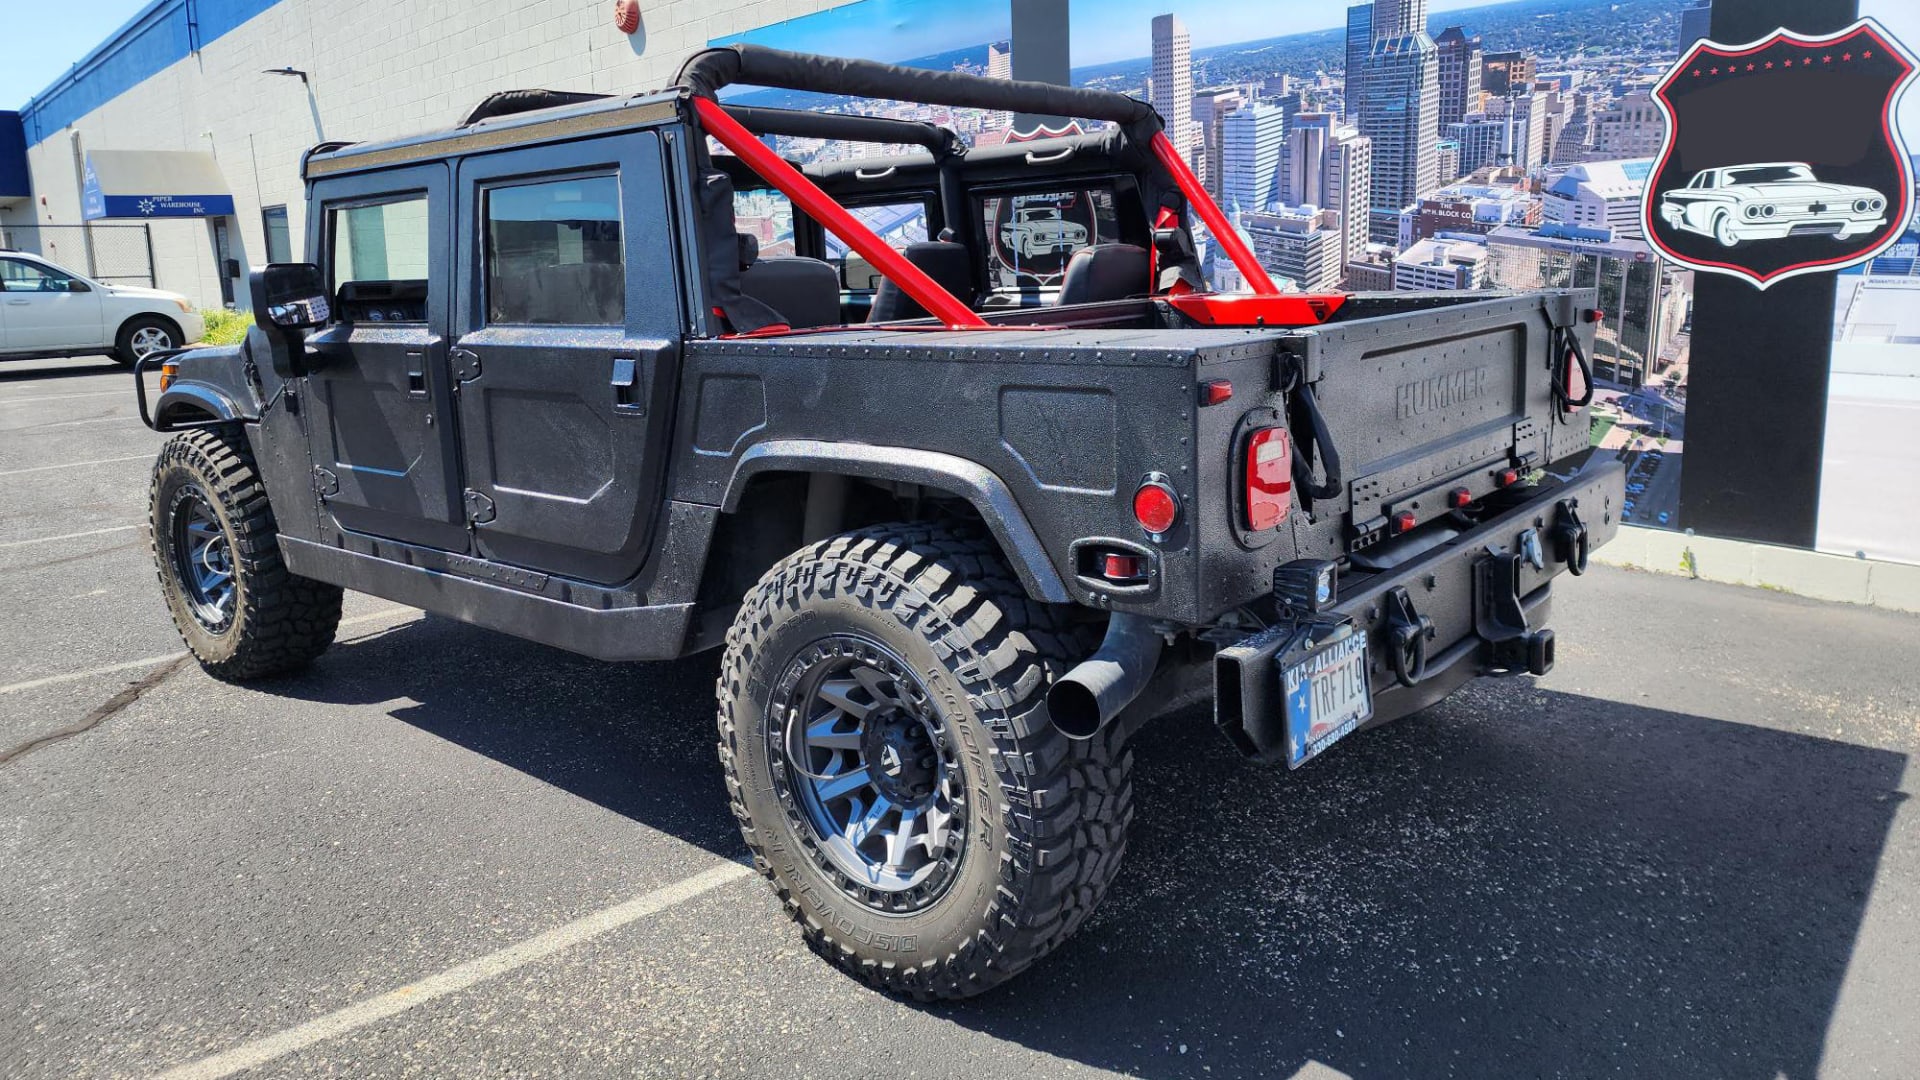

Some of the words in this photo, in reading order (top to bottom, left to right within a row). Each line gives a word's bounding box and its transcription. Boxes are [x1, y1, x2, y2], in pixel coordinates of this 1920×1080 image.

[1438, 210, 1459, 218] BLOCK
[1396, 365, 1489, 420] HUMMER
[1287, 662, 1308, 690] KIA
[1314, 630, 1367, 674] ALLIANCE
[927, 667, 994, 851] COOPER
